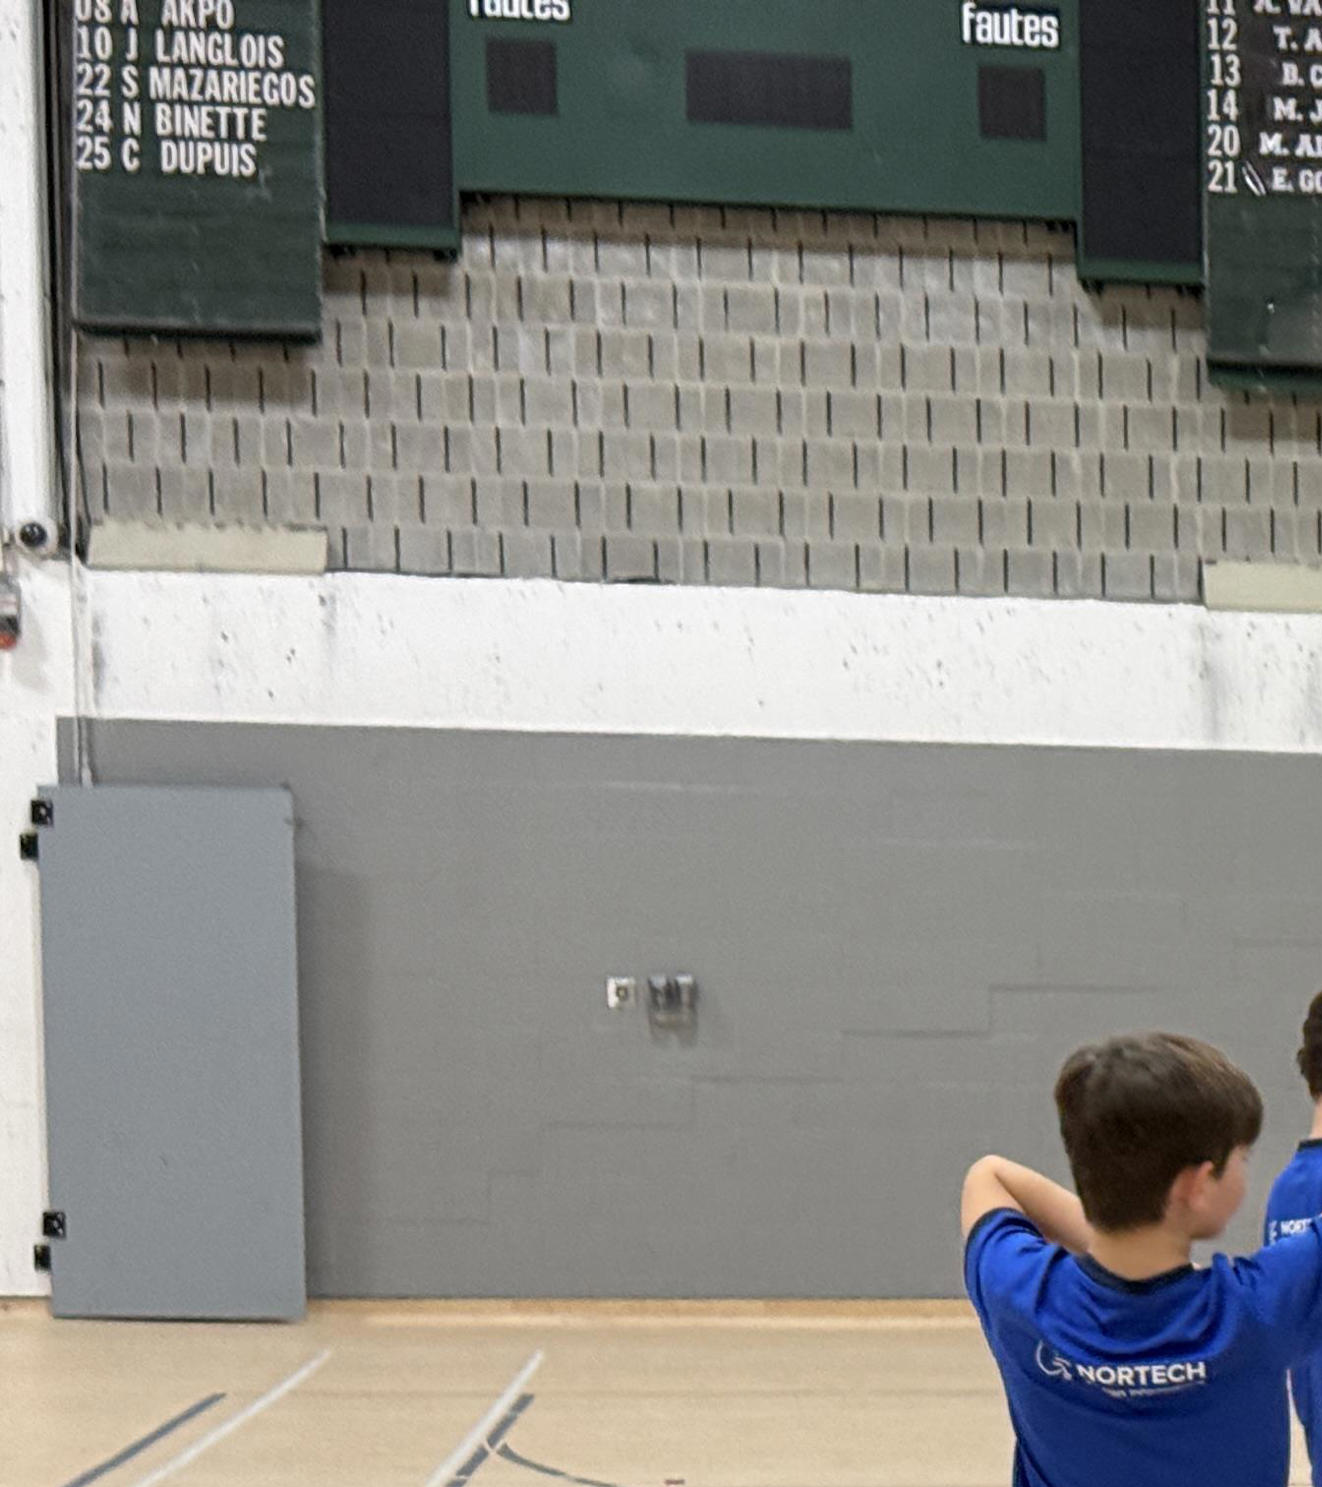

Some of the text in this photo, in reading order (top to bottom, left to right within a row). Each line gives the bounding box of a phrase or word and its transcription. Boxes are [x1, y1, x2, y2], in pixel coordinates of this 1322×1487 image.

[160, 0, 235, 30] AKPO
[76, 26, 285, 69] 10 J LANGLOIS
[1207, 17, 1238, 50] 12
[1273, 25, 1299, 50] T.
[76, 62, 316, 109] 22 S MAZARIEGOS
[1210, 53, 1241, 87] 13
[76, 99, 268, 142] 24 N BINETTE
[1207, 88, 1238, 122] 14
[1273, 96, 1304, 121] M.
[76, 136, 257, 178] 25 C DUPUIS
[1207, 124, 1241, 157] 20
[1258, 131, 1290, 156] M.
[1207, 160, 1238, 194] 21
[1272, 166, 1295, 192] E.
[1076, 1361, 1207, 1386] NORTECH
